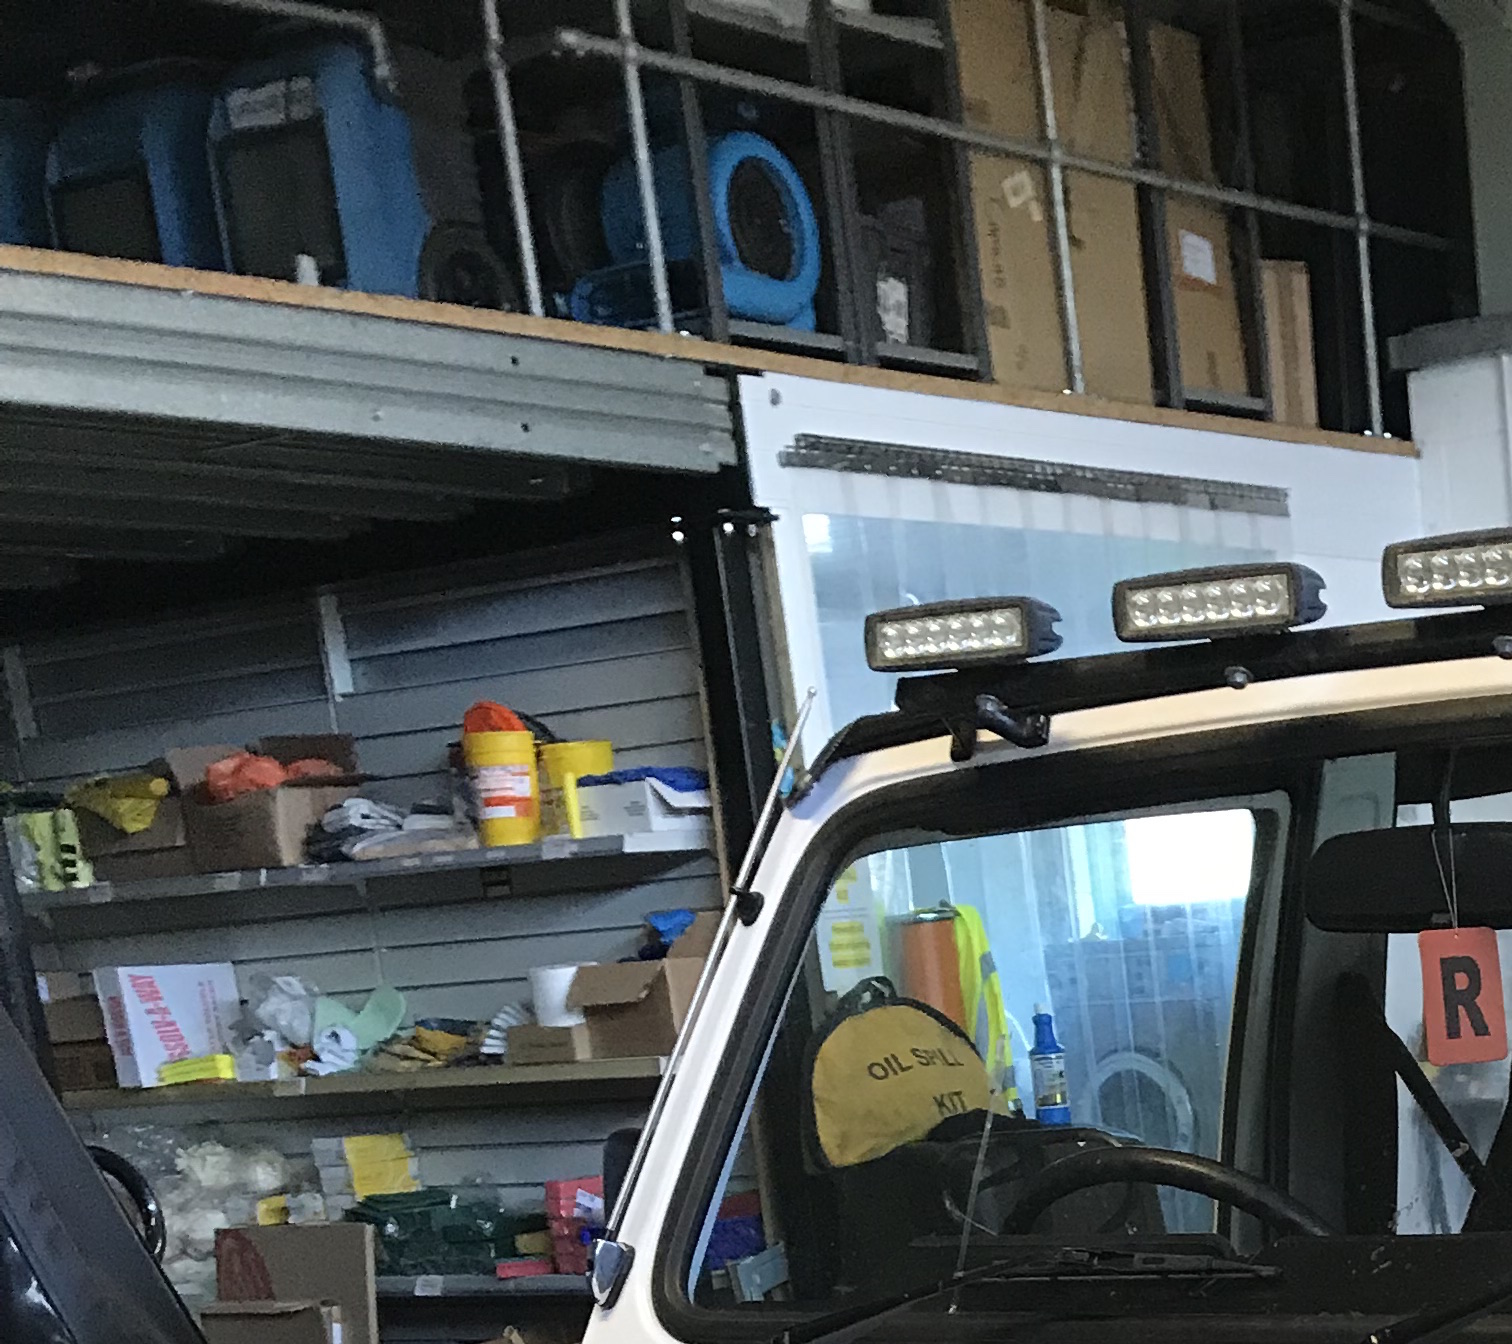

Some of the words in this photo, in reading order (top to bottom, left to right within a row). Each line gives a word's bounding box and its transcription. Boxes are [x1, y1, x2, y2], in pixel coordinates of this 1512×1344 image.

[1440, 956, 1491, 1039] R
[867, 1053, 913, 1080] OIL
[933, 1091, 967, 1115] KIT
